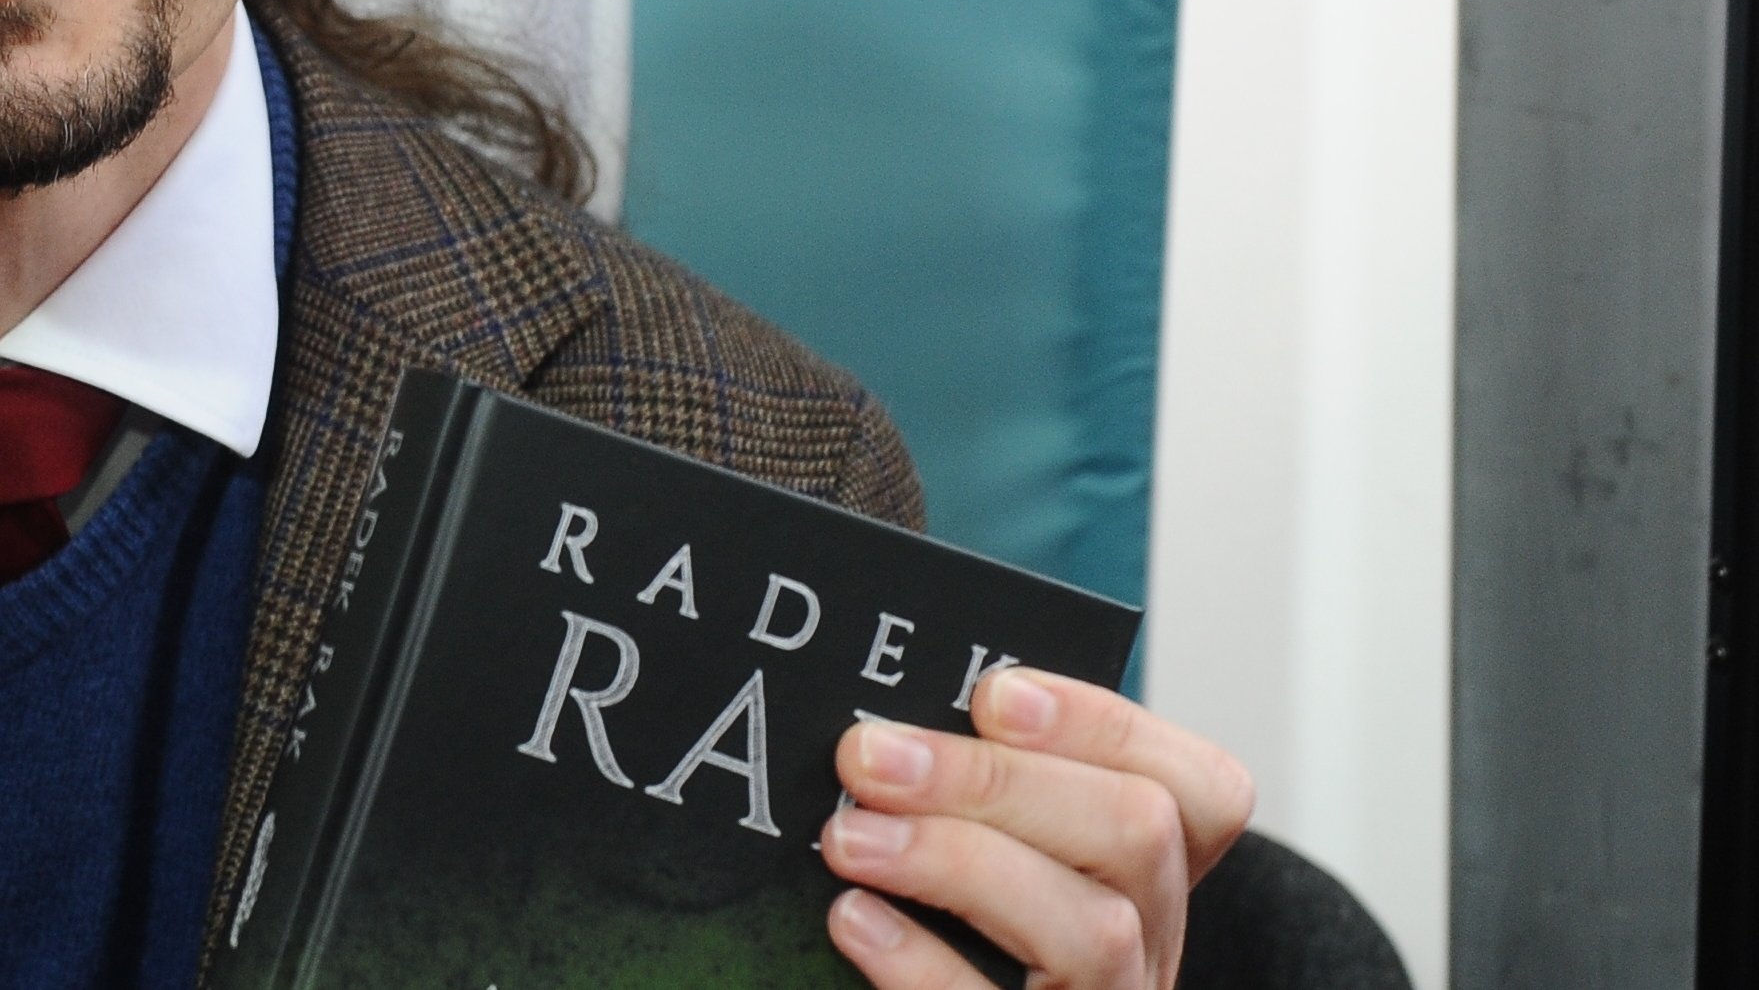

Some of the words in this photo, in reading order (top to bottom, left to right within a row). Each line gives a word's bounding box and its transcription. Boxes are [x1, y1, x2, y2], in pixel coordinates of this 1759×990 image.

[332, 428, 404, 617] RADEK
[287, 643, 336, 760] RAK
[516, 609, 900, 852] RA
